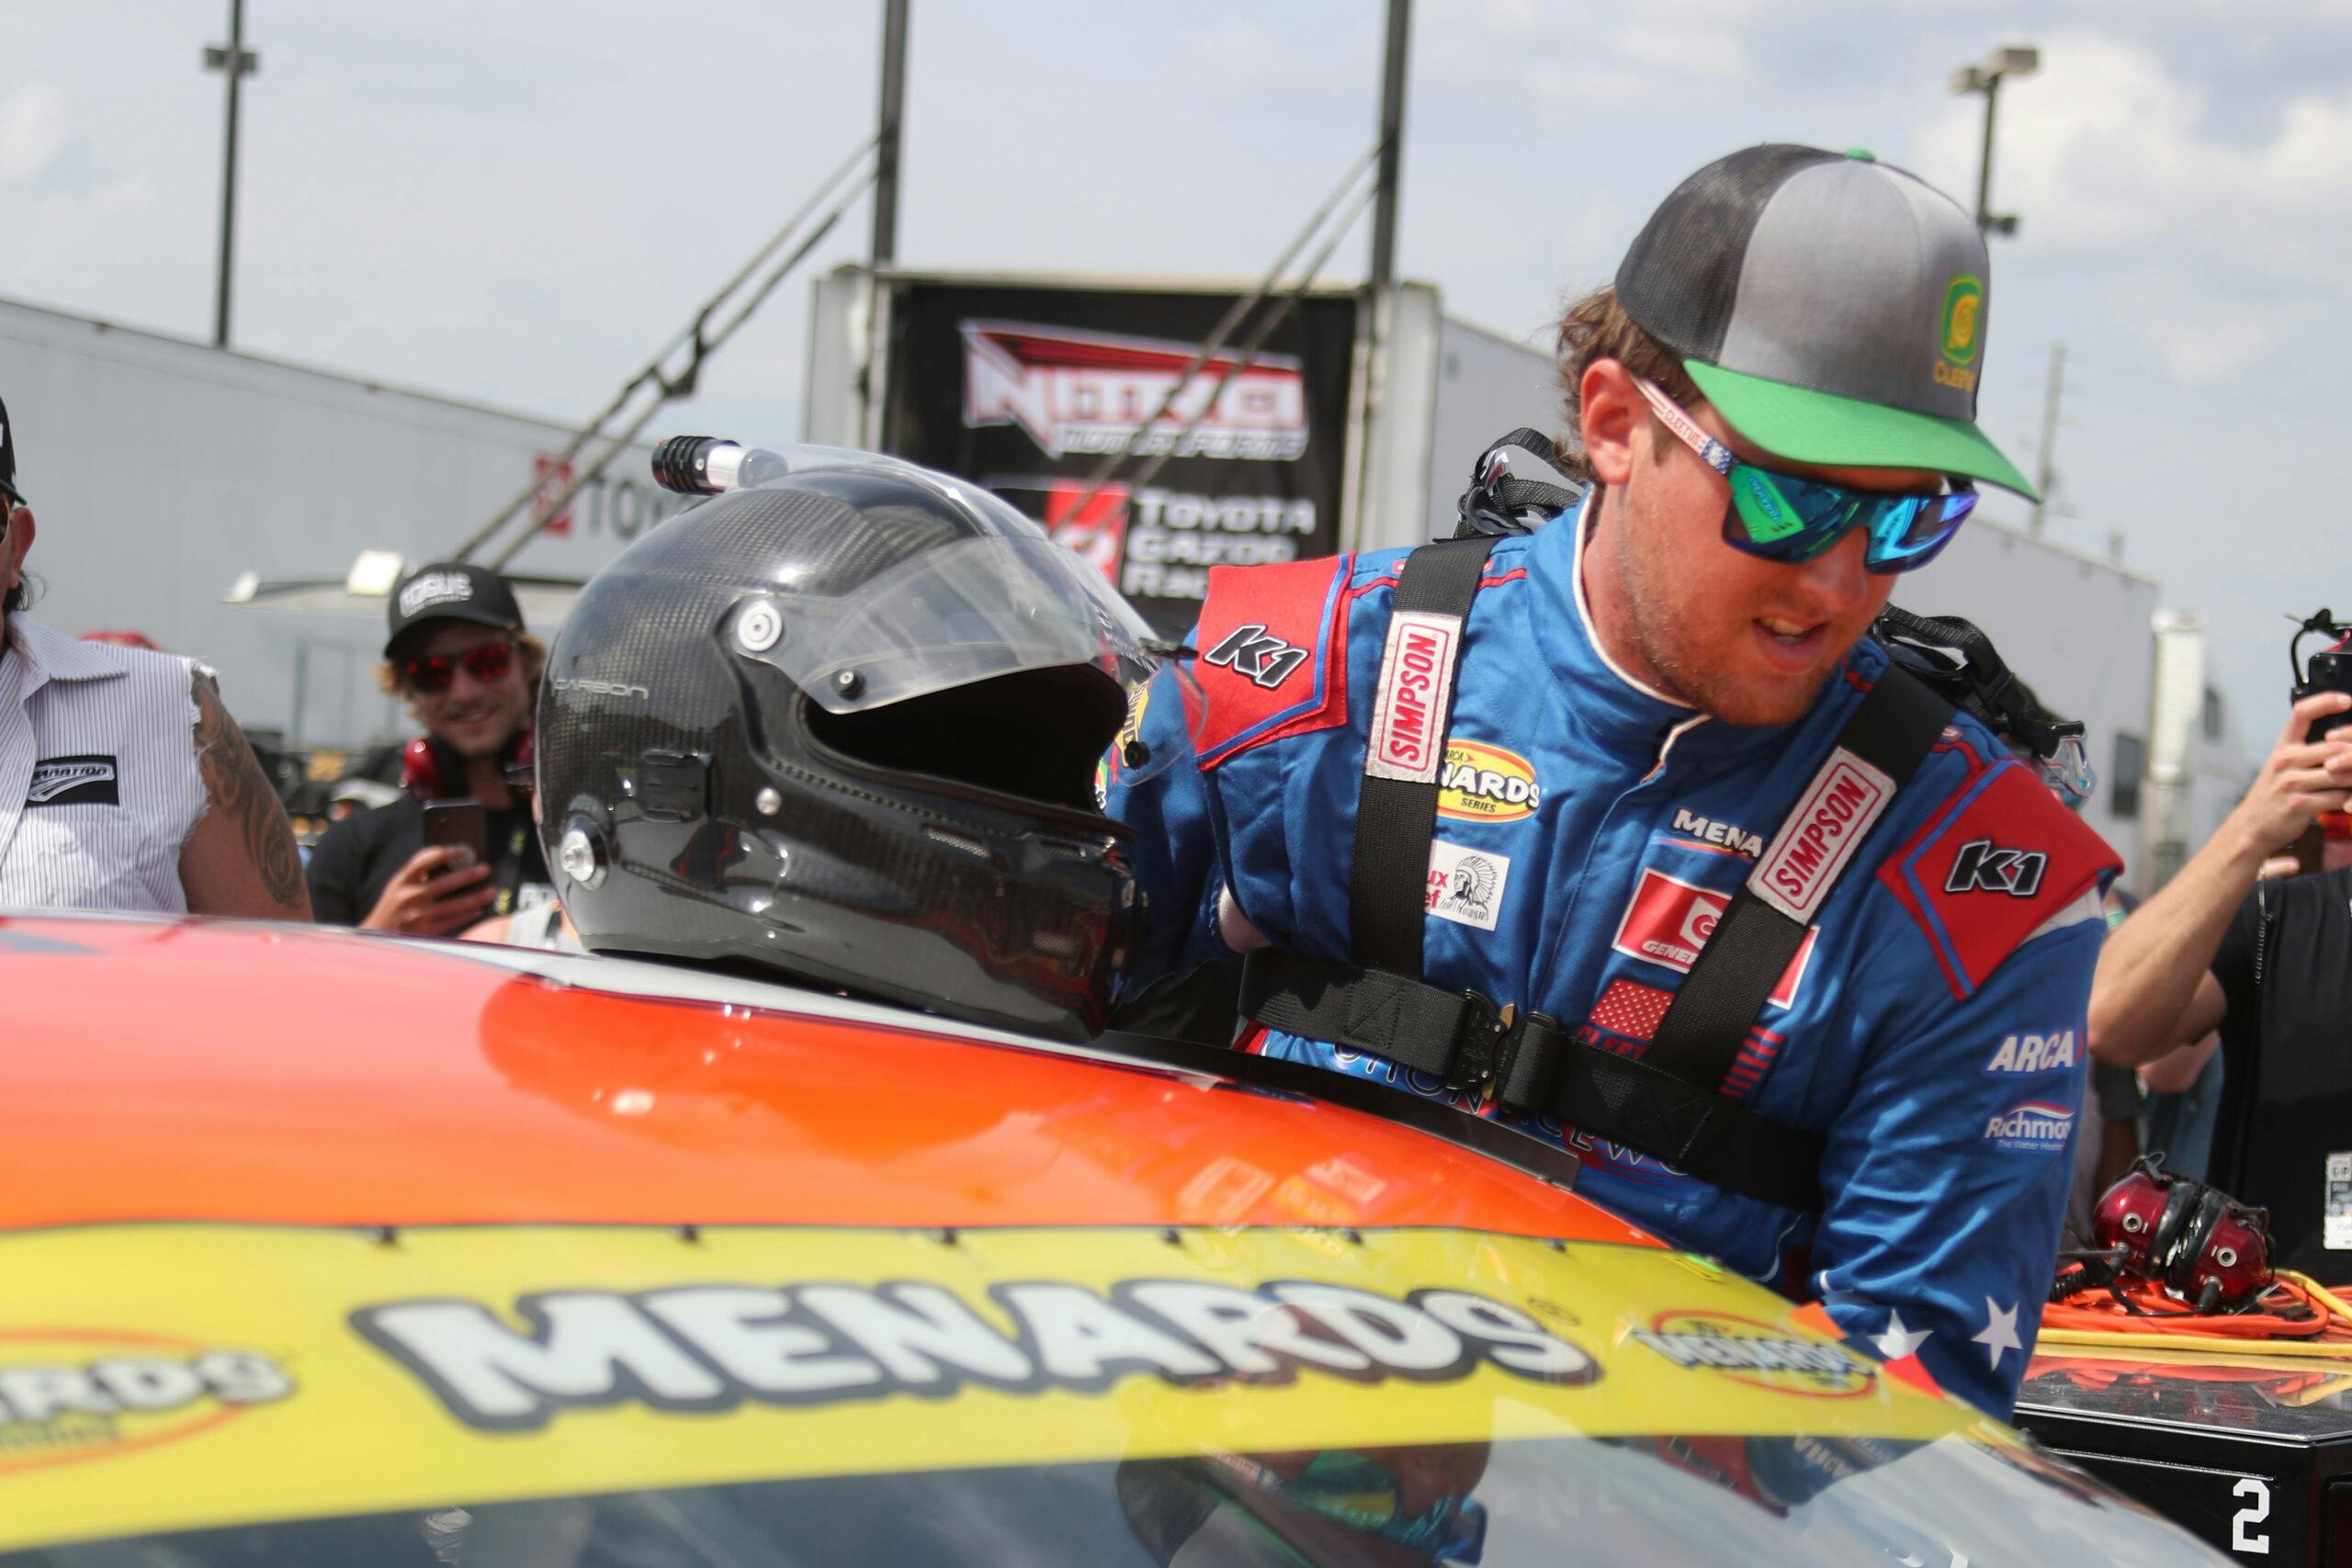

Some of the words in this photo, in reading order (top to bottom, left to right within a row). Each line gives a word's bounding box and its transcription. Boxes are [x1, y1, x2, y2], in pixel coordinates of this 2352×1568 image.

[1132, 489, 1316, 535] TOYOTA
[1204, 624, 1309, 687] K1
[1390, 633, 1438, 761] SIMPSON
[1461, 797, 1497, 813] SERIES
[1673, 808, 1763, 858] MENA
[1776, 774, 1867, 897] SIMPSON
[1945, 840, 2046, 897] K1
[1986, 1031, 2074, 1073] ARCA
[347, 1280, 1603, 1437] MENARDS
[2232, 1477, 2270, 1554] 2
